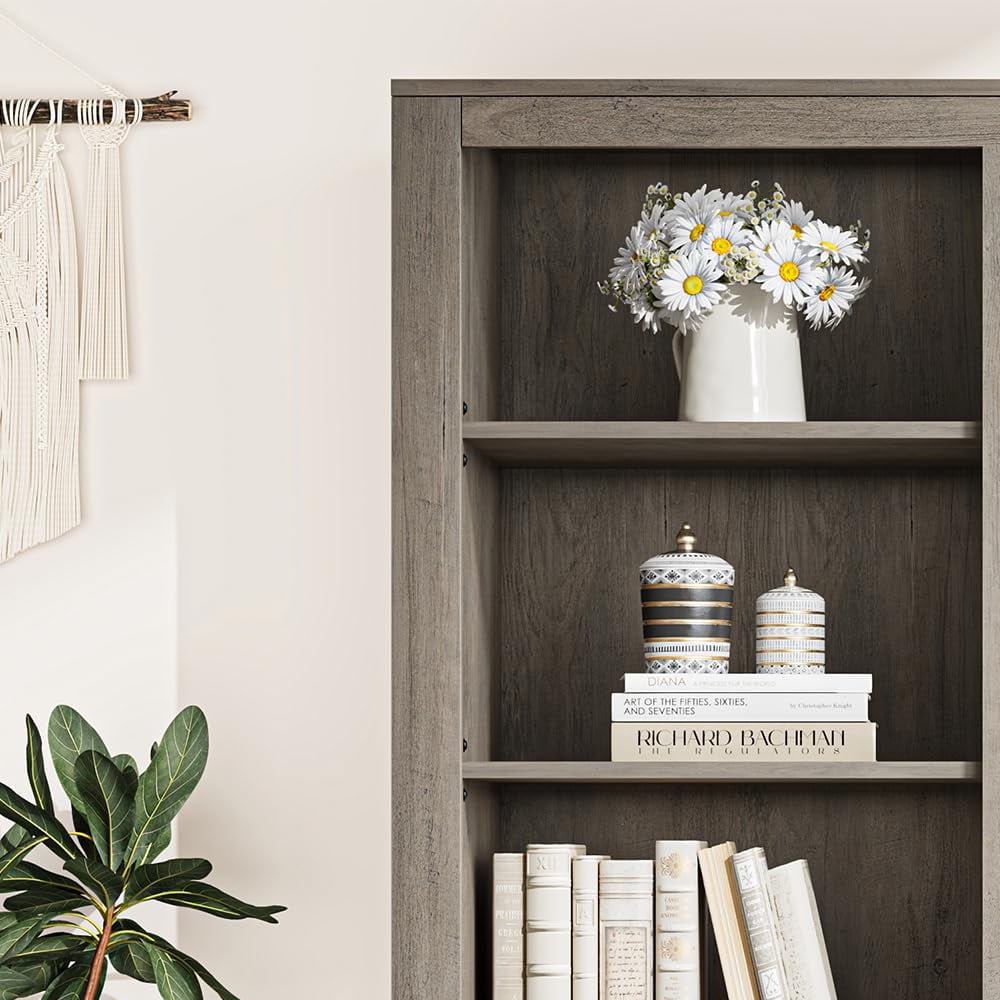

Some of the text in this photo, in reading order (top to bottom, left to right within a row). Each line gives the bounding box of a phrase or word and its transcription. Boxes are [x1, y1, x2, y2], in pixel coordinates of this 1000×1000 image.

[647, 677, 687, 687] DIANA
[623, 698, 748, 707] ART OF THE FIFTIES, SIXTIES,
[623, 707, 696, 715] AND SEVENTIES
[637, 730, 845, 747] RICHARD BACHMAN
